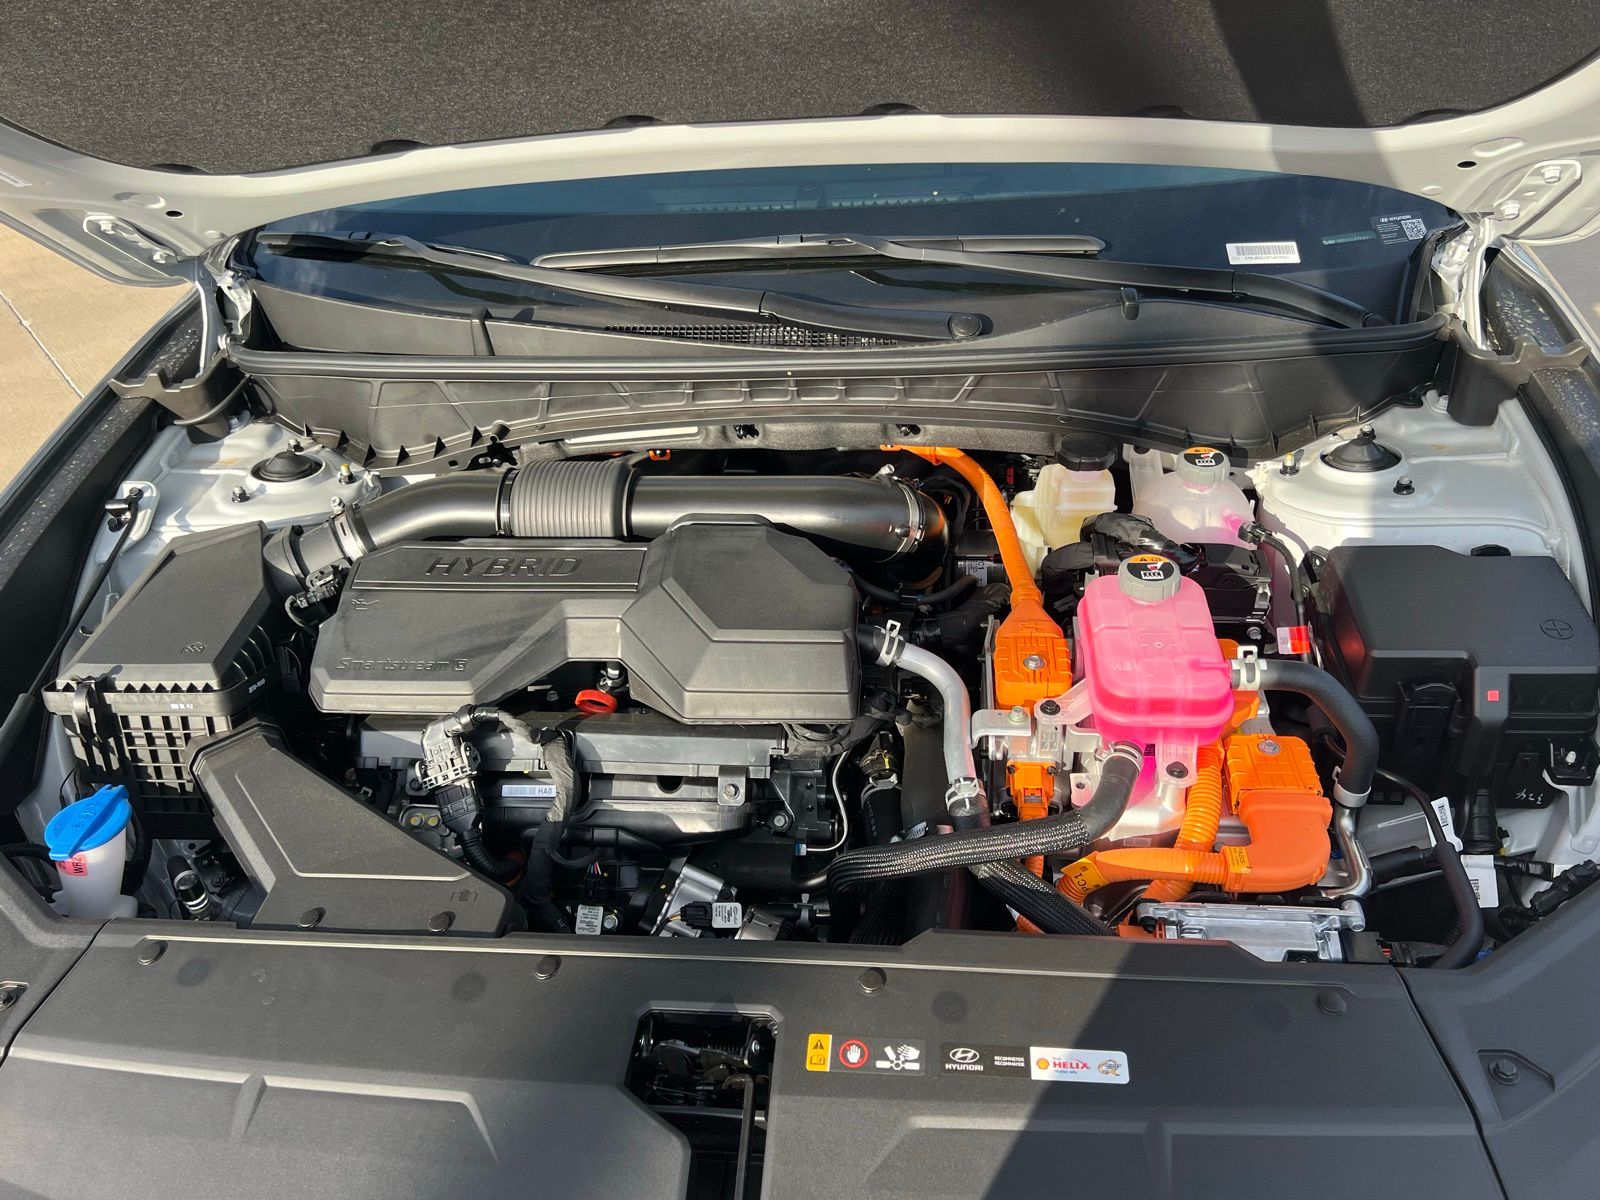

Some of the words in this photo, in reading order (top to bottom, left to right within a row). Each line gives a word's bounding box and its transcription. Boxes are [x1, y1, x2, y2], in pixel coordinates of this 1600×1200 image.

[425, 556, 582, 577] HYBRID
[336, 658, 450, 670] Smartstream
[945, 1063, 984, 1071] HYUNDAI
[1053, 1060, 1091, 1069] HELIX
